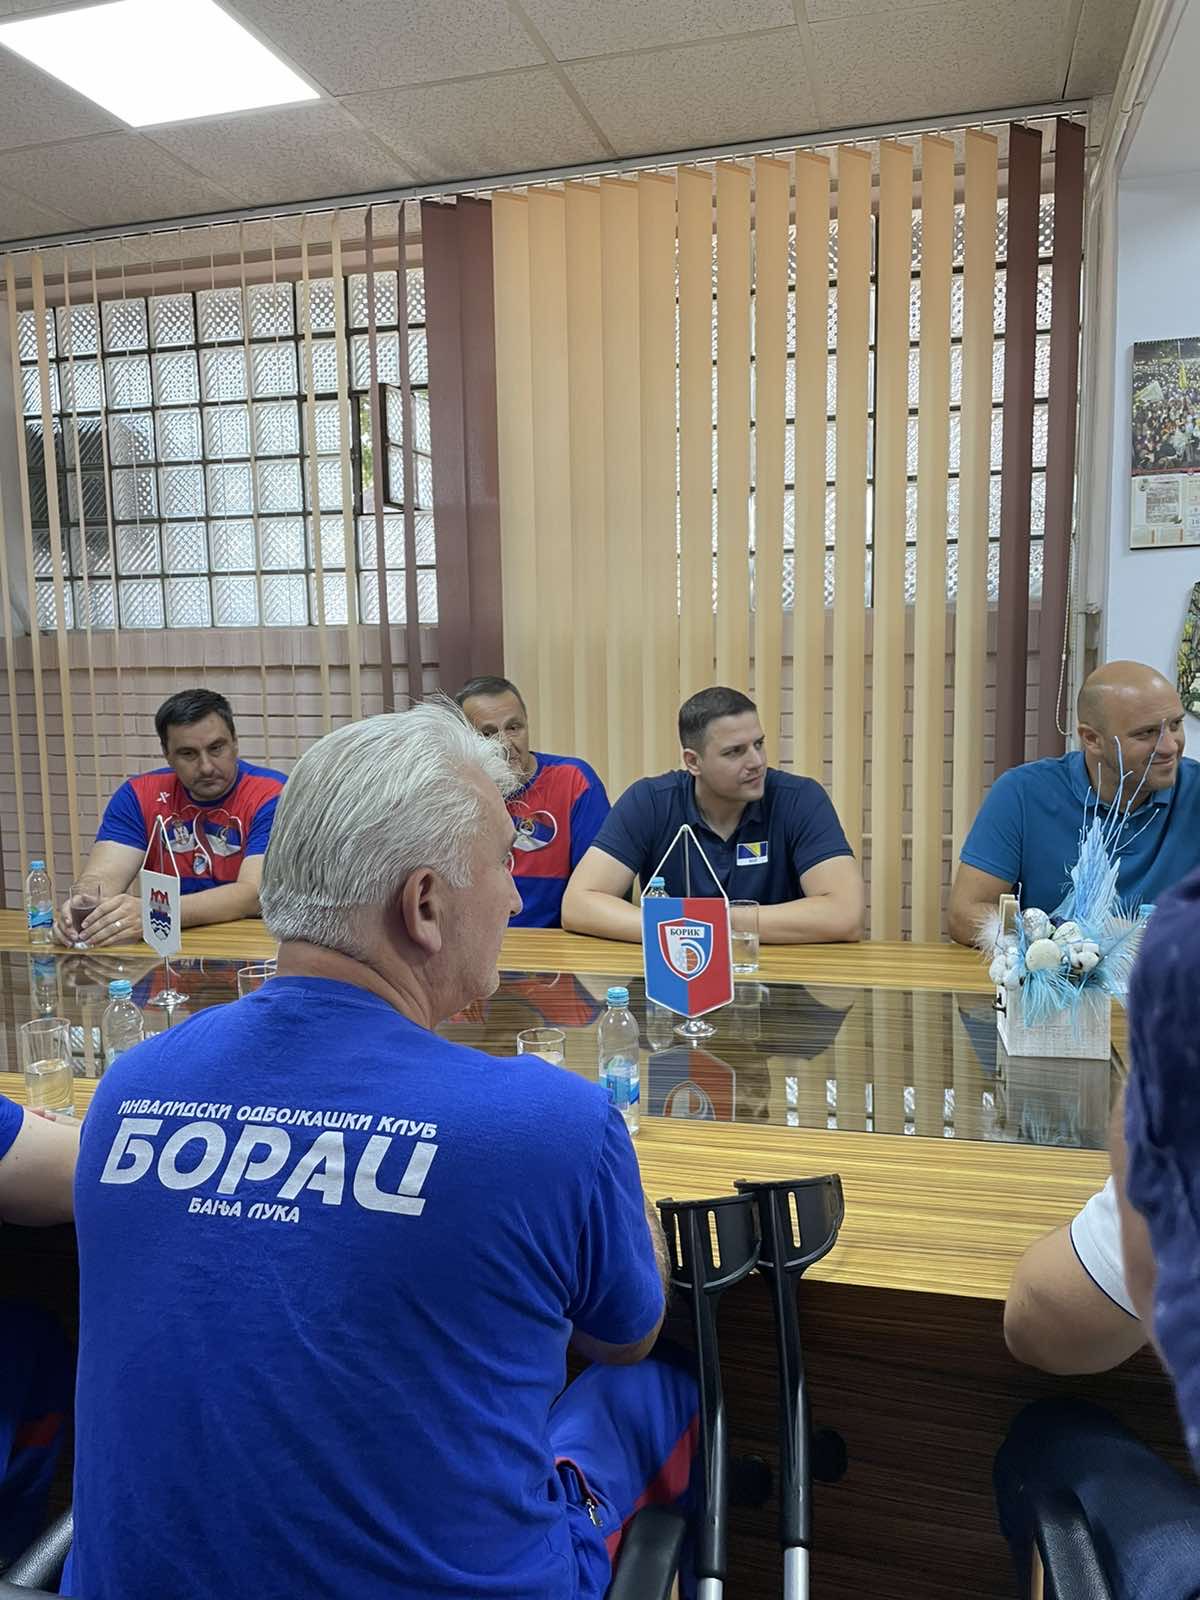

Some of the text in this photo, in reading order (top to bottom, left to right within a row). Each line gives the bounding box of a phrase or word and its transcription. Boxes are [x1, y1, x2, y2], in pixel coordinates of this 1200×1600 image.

[669, 927, 701, 937] БОРИК
[118, 1099, 438, 1139] ИНВАЛИДСКИ ОДБОЈКАШКИ КЛУБ
[99, 1117, 439, 1217] БОРАЦ
[188, 1197, 300, 1224] БАЊА ЛУКА
